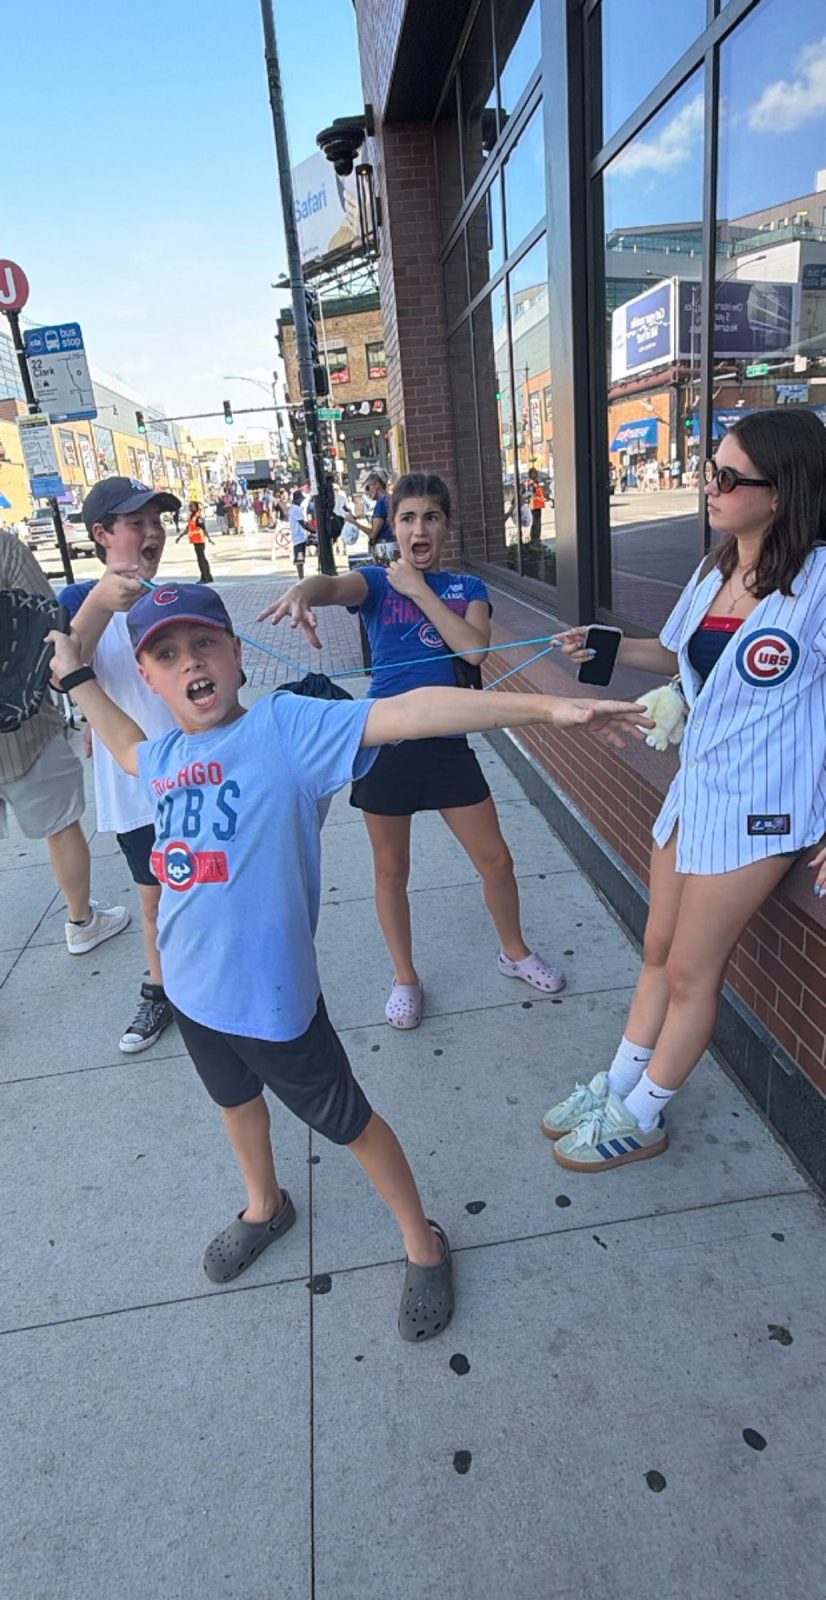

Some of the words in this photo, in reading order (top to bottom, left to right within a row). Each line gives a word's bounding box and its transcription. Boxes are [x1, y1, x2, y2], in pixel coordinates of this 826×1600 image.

[295, 183, 327, 223] Safari
[60, 327, 76, 338] bus
[61, 338, 80, 349] stop
[31, 359, 42, 369] 22
[32, 367, 55, 378] Clark
[383, 599, 419, 625] CHA
